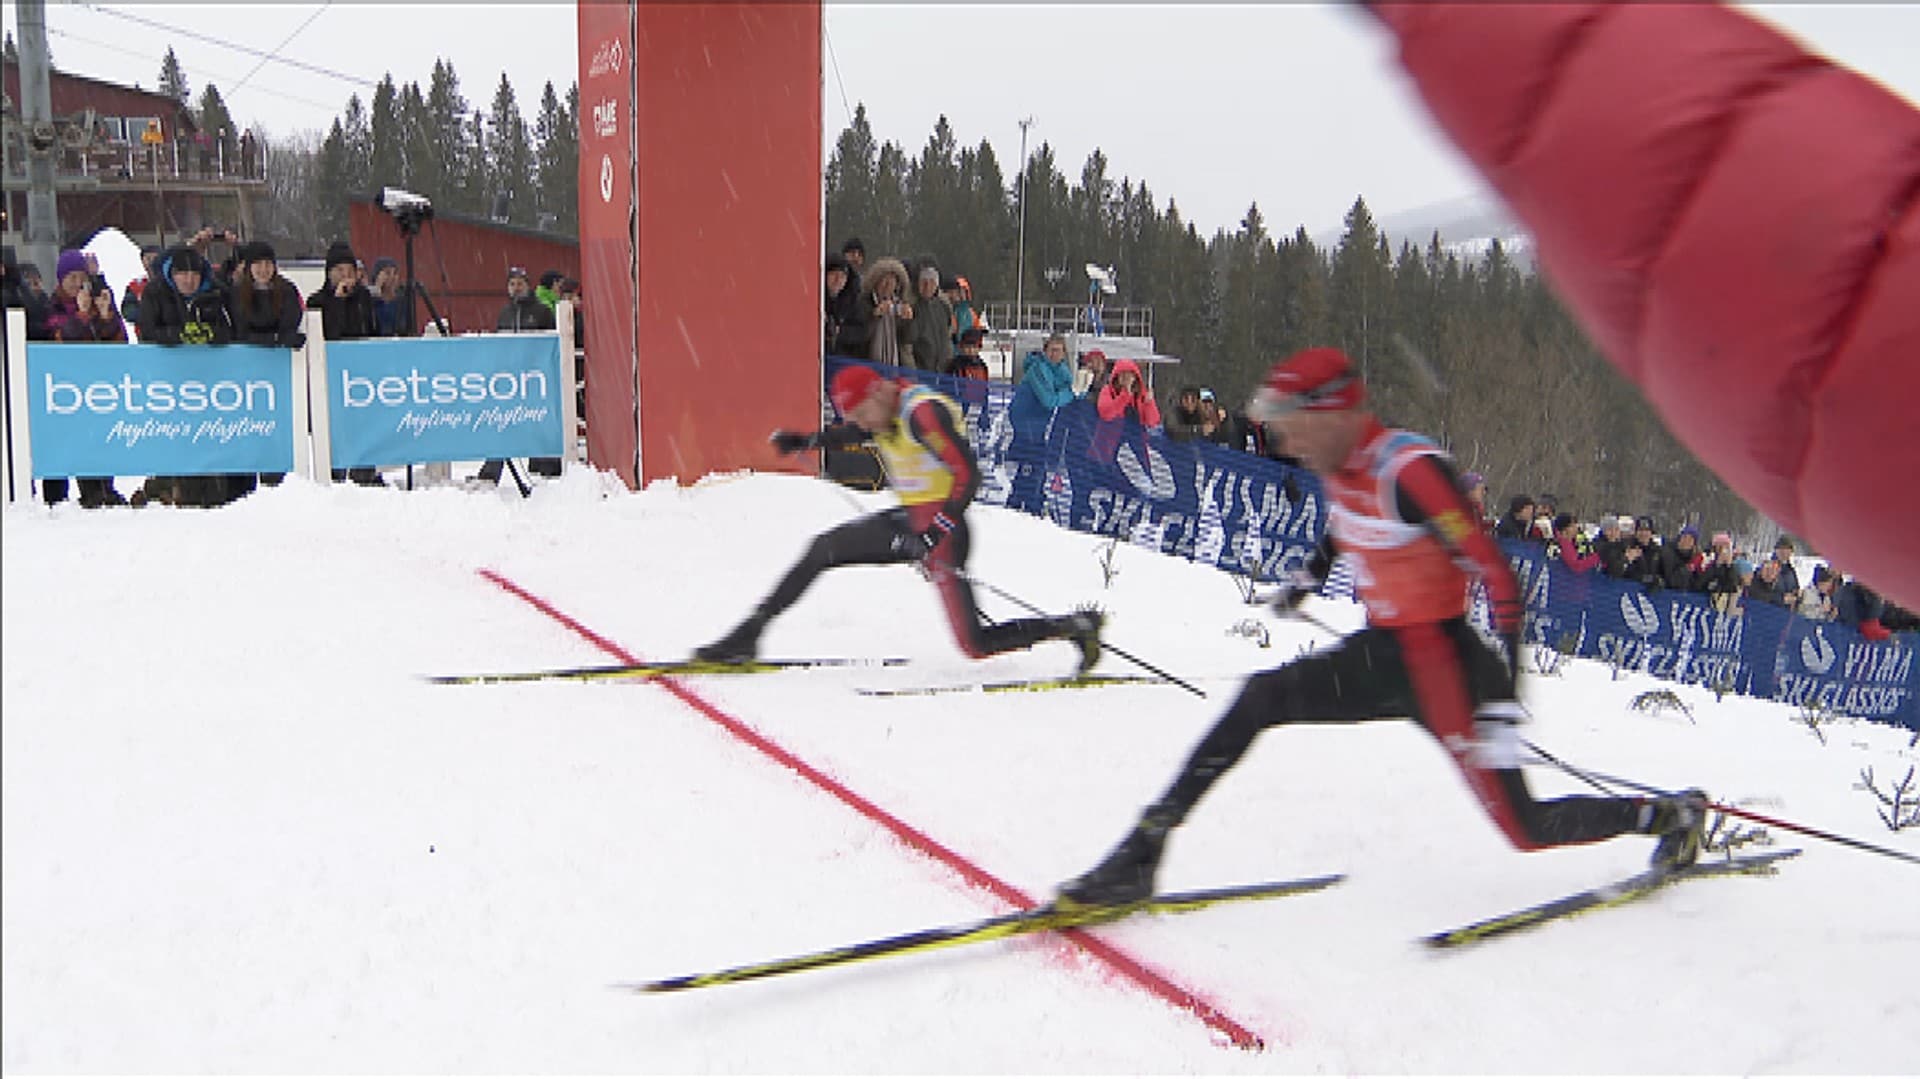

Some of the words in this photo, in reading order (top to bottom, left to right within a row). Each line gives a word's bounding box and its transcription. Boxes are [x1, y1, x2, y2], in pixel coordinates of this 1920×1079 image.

[45, 373, 276, 415] betsson
[341, 368, 548, 408] betsson
[105, 419, 191, 448] Anytime's
[397, 408, 472, 437] Anytime's
[1195, 460, 1318, 543] VISMA
[1671, 601, 1743, 654] VISMA
[1844, 643, 1913, 683] VISMA
